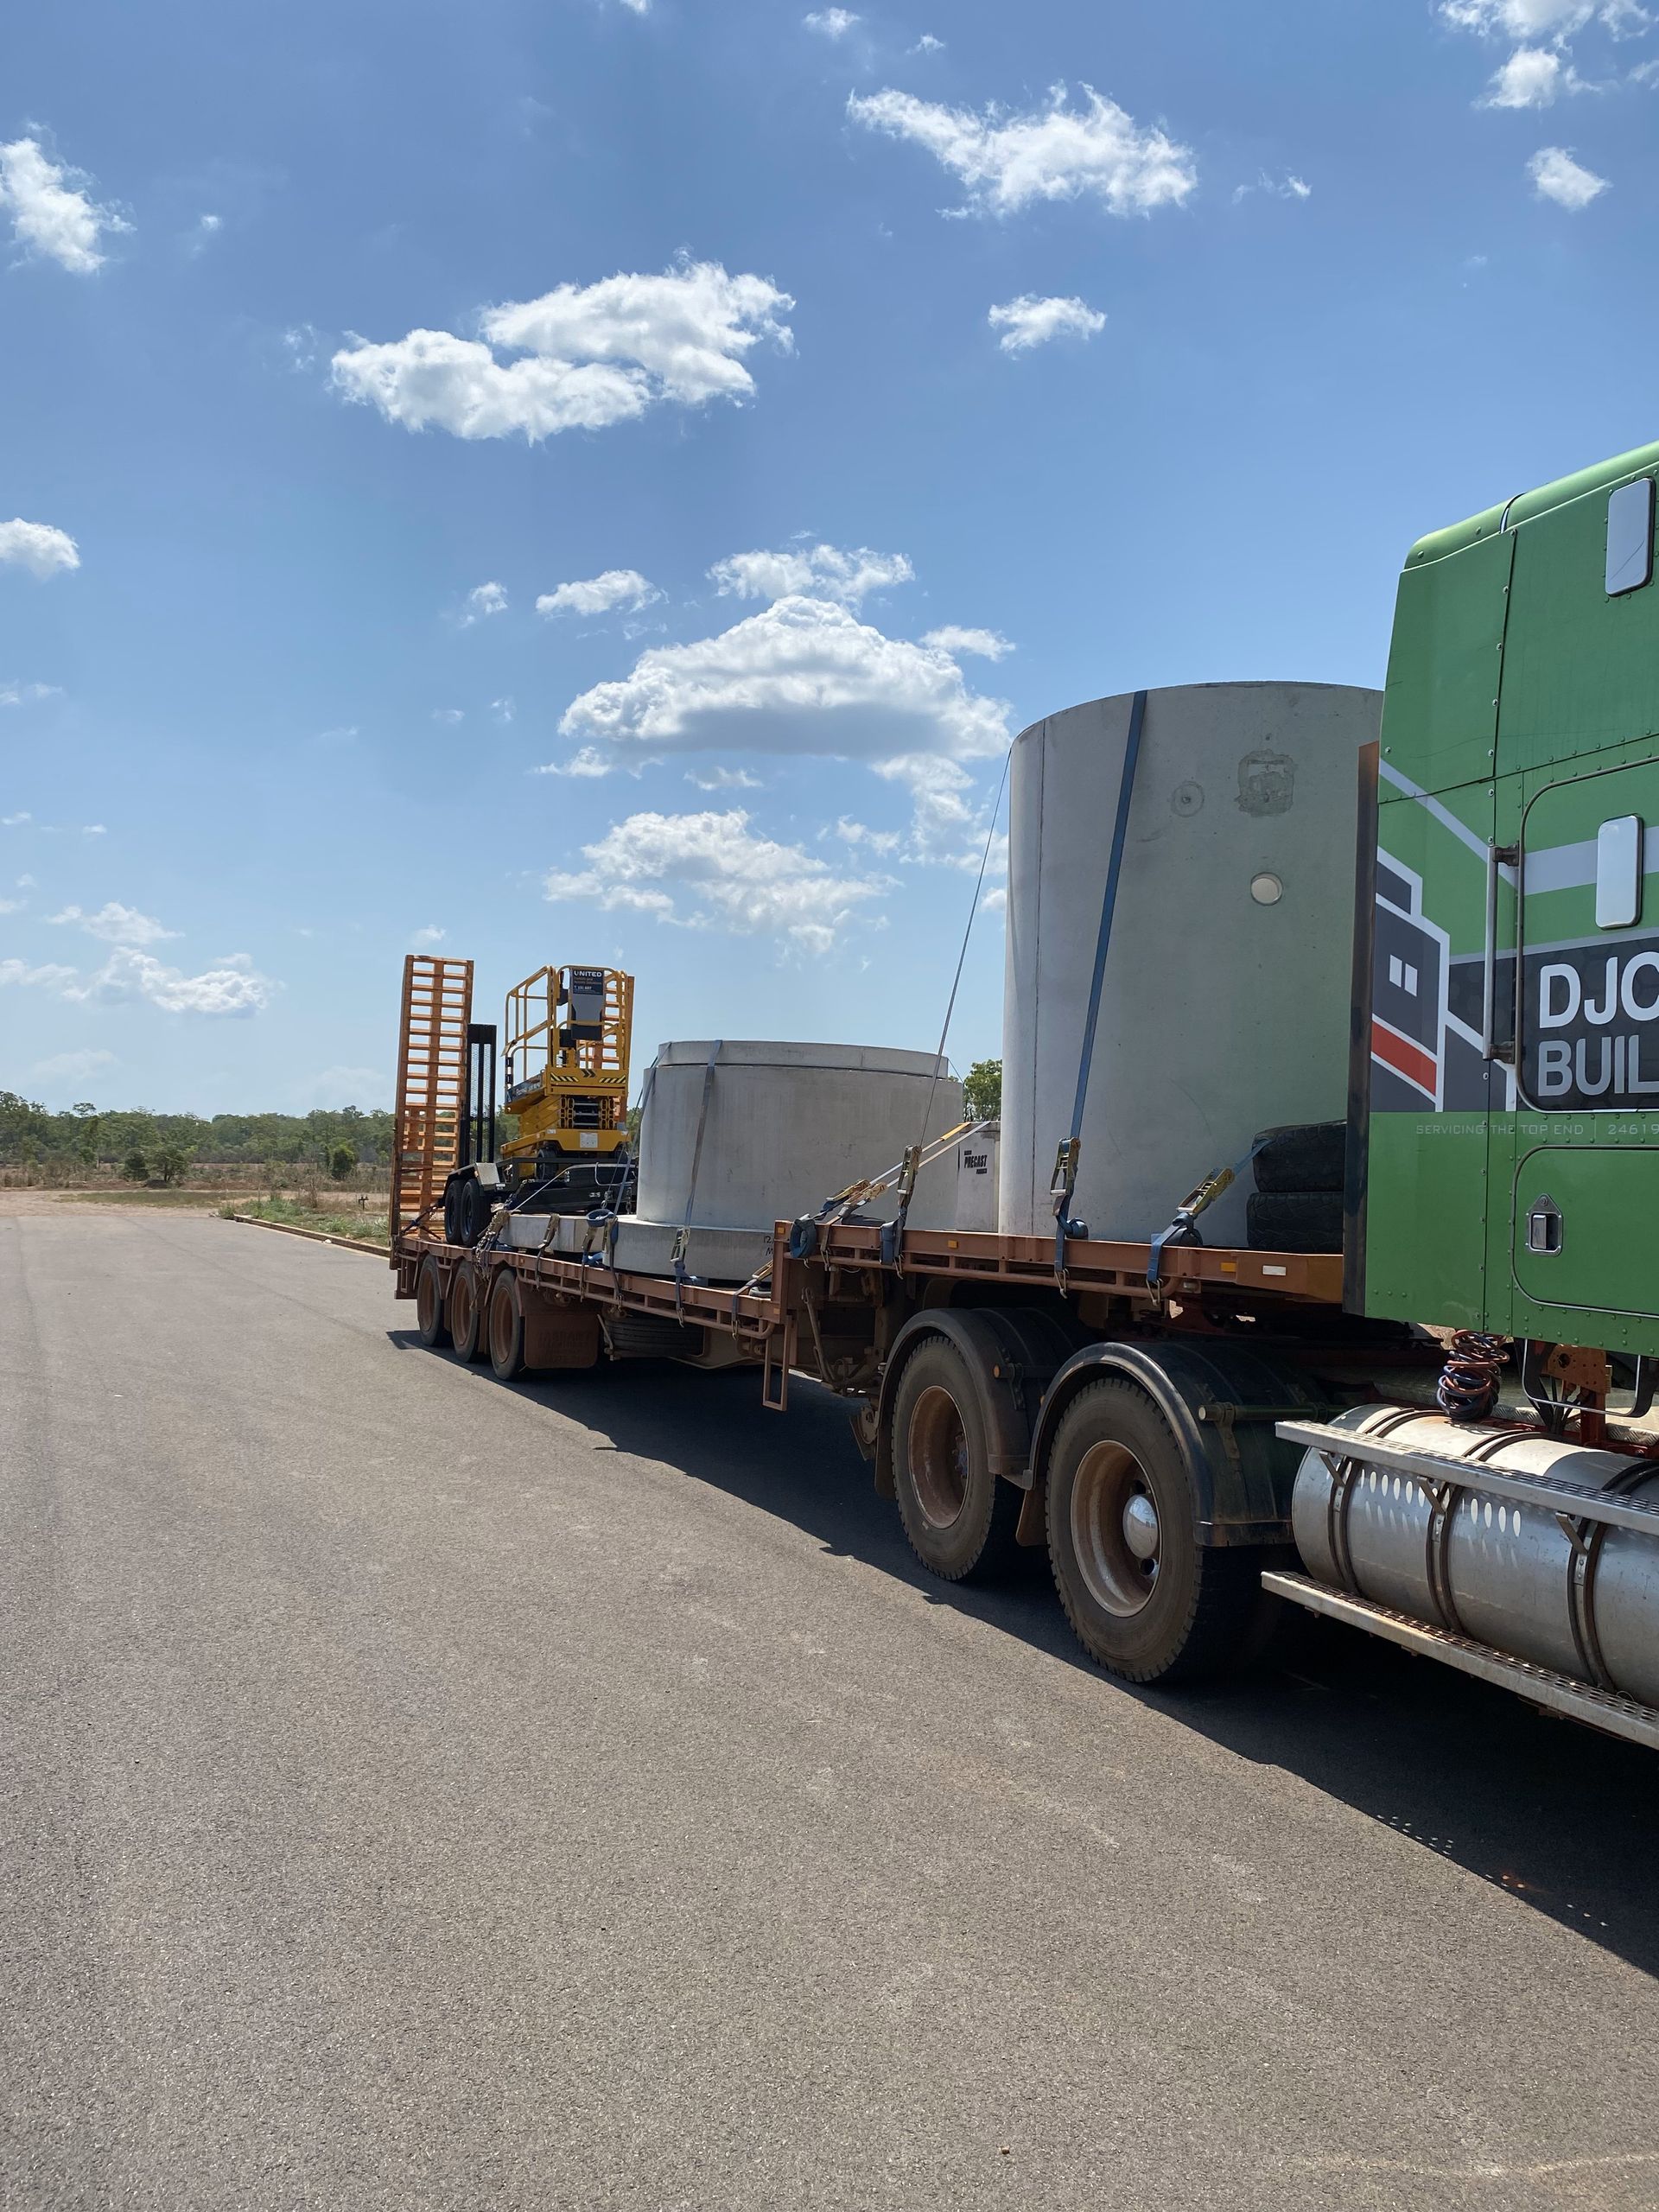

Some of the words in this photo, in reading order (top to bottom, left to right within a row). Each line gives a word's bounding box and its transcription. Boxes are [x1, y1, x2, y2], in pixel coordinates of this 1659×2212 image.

[1538, 1035, 1659, 1096] BUIL
[1416, 1125, 1484, 1135] SERVICING
[1491, 1125, 1516, 1135] THE
[1521, 1125, 1548, 1134] TOP
[1554, 1125, 1584, 1135] END
[964, 1154, 988, 1168] PRECAST
